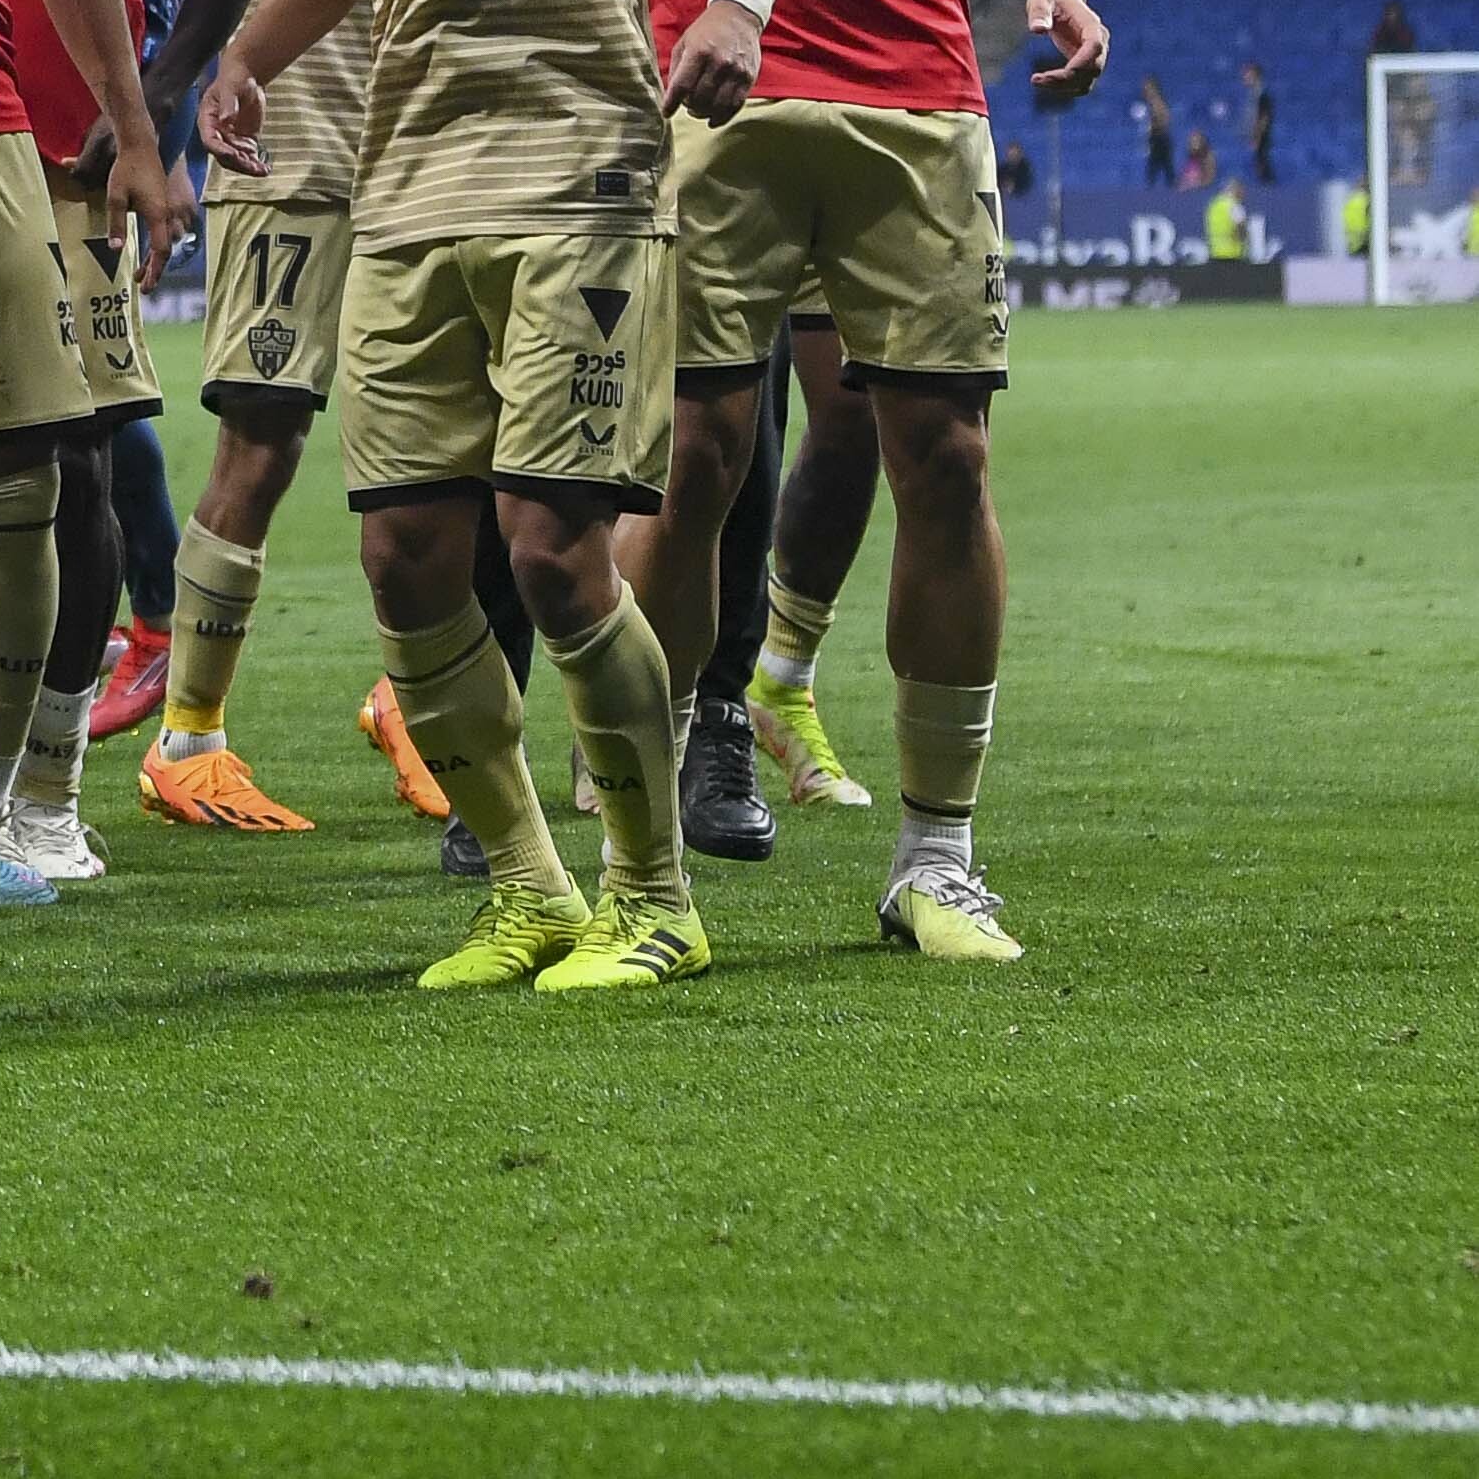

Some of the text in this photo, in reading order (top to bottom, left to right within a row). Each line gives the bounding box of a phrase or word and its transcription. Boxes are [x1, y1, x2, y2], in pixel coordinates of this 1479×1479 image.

[247, 232, 312, 310] 17
[91, 315, 128, 341] KUD
[253, 330, 265, 341] U
[569, 377, 625, 409] KUDU
